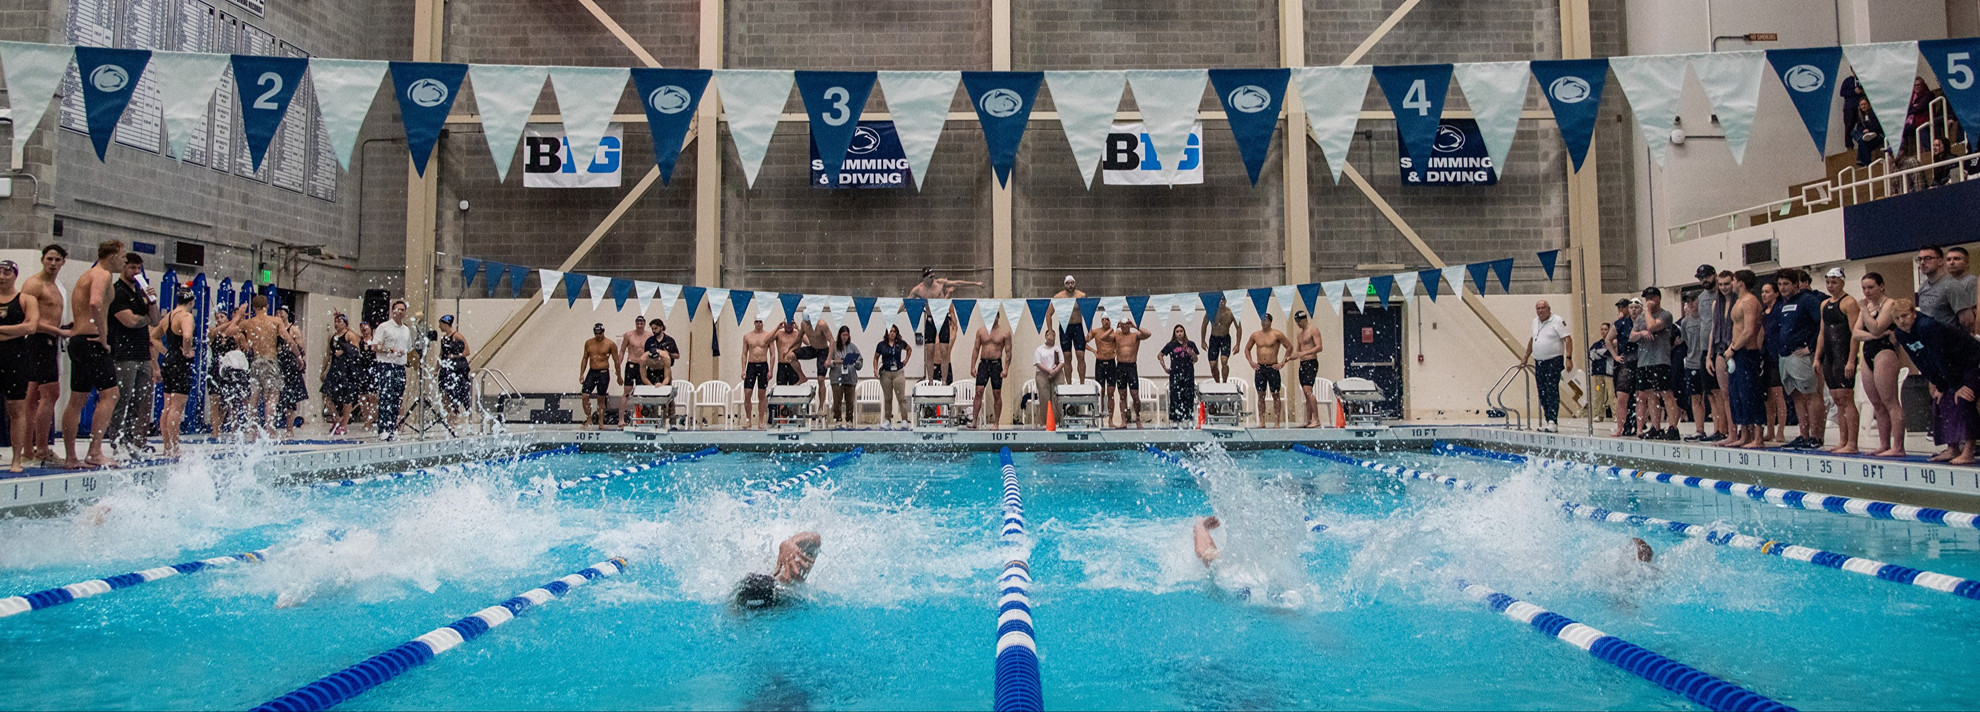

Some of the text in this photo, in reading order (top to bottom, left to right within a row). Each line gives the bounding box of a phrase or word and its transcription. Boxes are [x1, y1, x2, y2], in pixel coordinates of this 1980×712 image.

[1947, 52, 1974, 90] 5
[253, 71, 283, 110] 2
[1402, 79, 1431, 116] 4
[822, 86, 850, 126] 3
[811, 158, 909, 171] SIMMING
[1400, 157, 1492, 168] SIMMING
[819, 172, 902, 185] & DIVING
[1407, 171, 1488, 182] & DIVING
[575, 432, 586, 440] 10
[992, 432, 1003, 441] 10
[1411, 428, 1422, 437] 10
[1616, 442, 1624, 453] 20
[1672, 446, 1681, 458] 25
[1738, 453, 1749, 466] 30
[1819, 460, 1832, 474] 35
[1920, 469, 1936, 485] 40
[82, 477, 97, 492] 40
